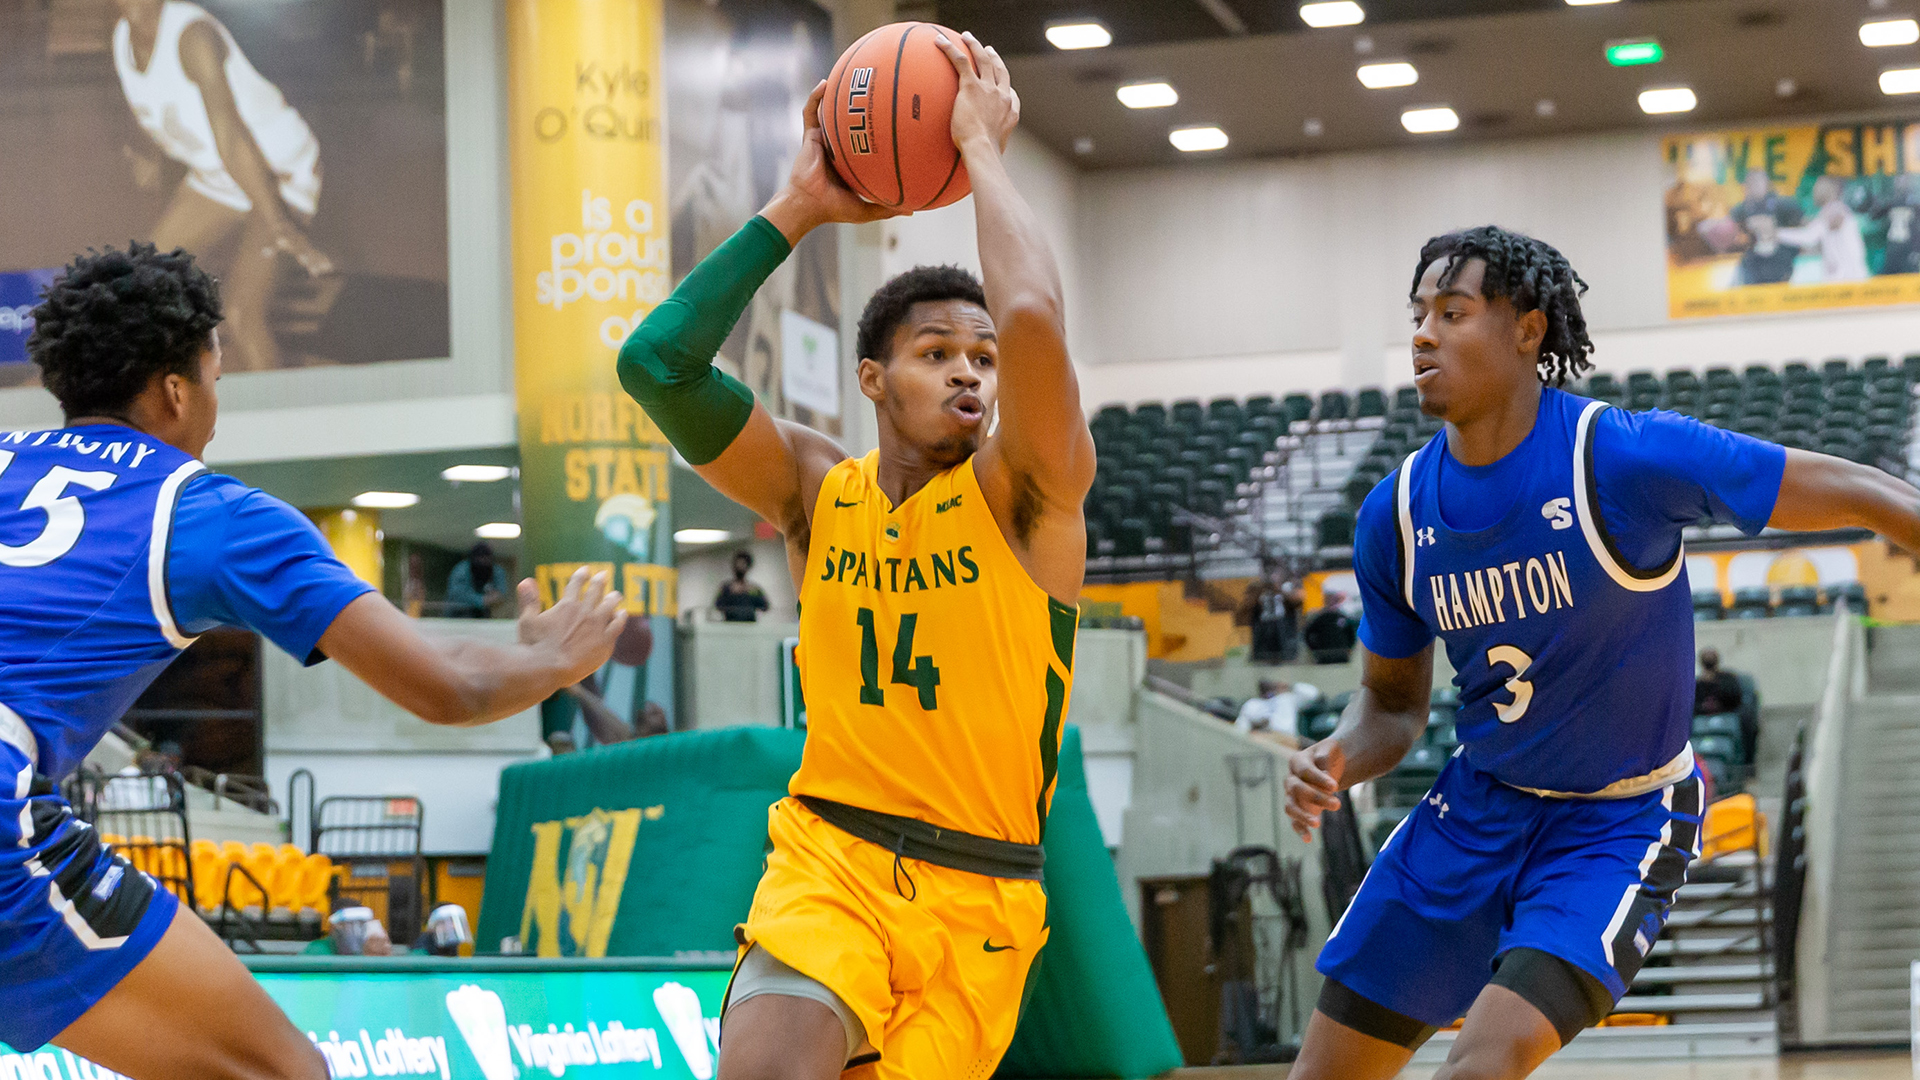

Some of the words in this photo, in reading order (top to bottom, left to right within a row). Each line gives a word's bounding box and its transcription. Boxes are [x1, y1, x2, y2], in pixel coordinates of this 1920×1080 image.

[575, 61, 651, 103] Kyle
[848, 66, 874, 156] ELITE
[582, 188, 613, 232] is
[625, 199, 653, 234] a
[1429, 550, 1574, 632] HAMPTON
[856, 607, 941, 711] 14
[1486, 645, 1535, 724] 3
[358, 1028, 452, 1080] Lottery
[507, 1021, 598, 1078] Virginia
